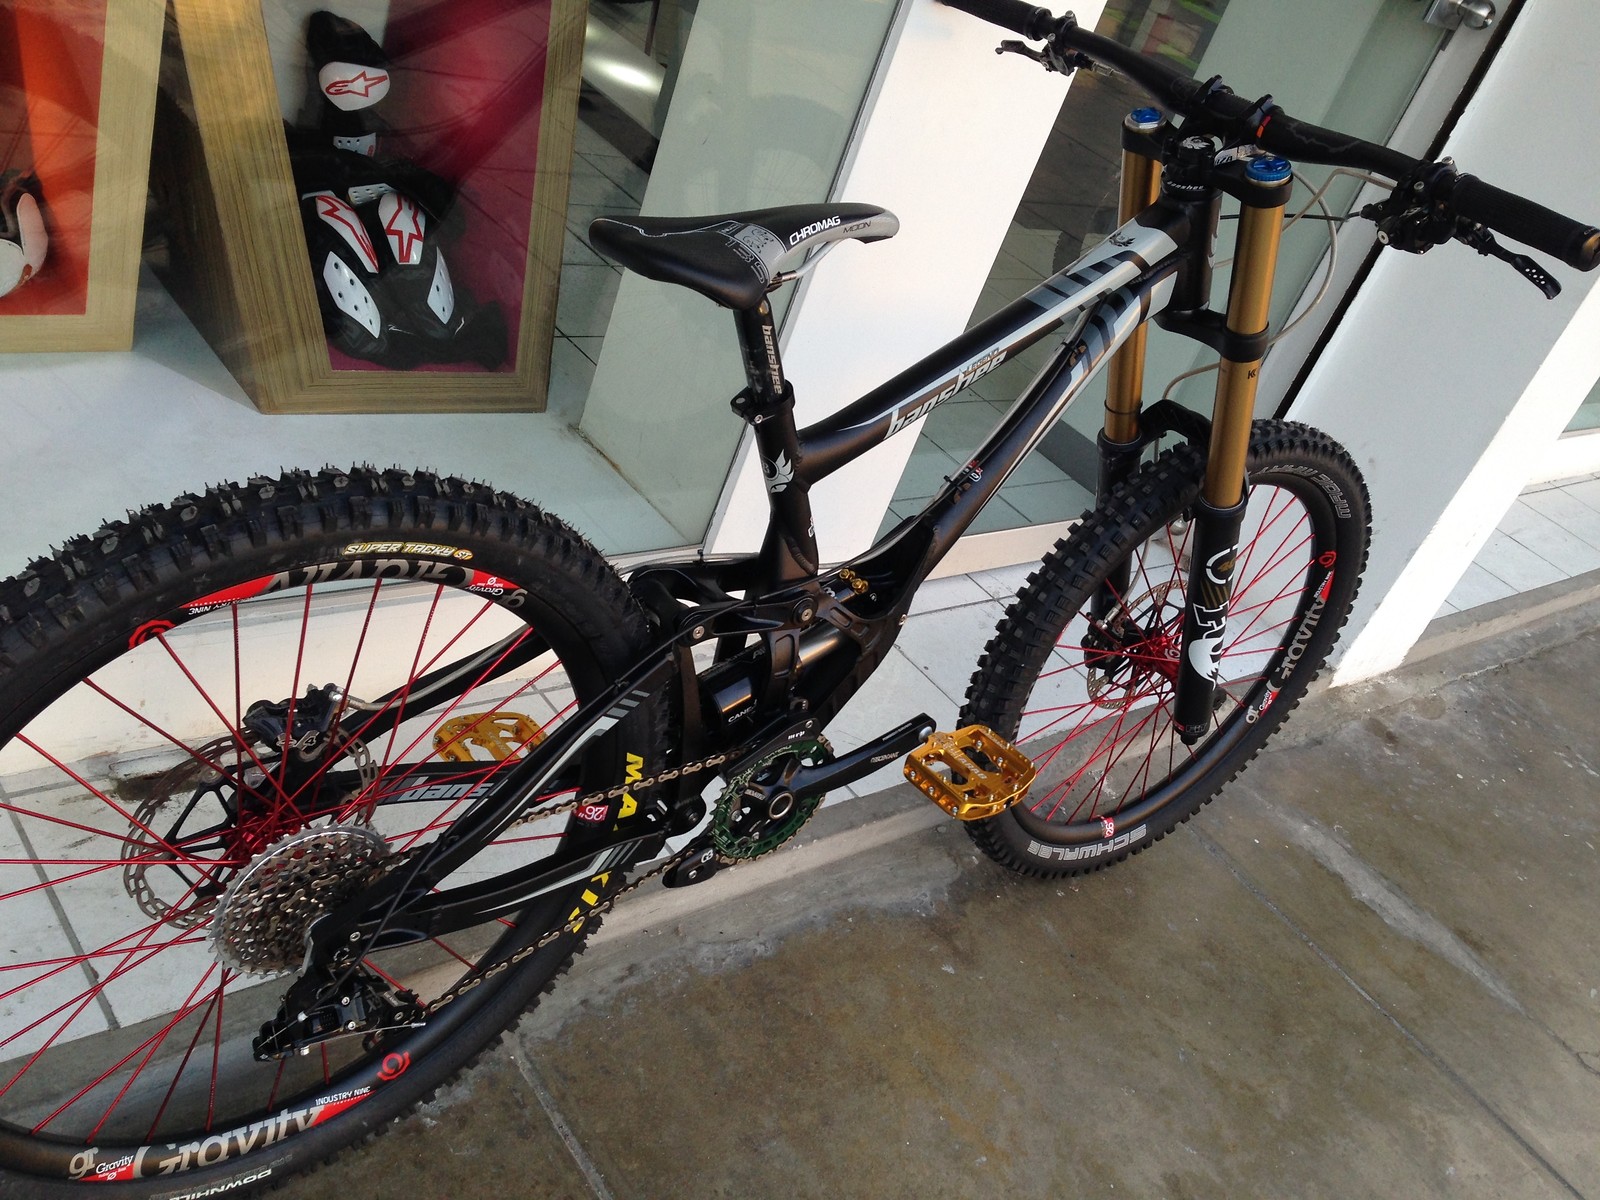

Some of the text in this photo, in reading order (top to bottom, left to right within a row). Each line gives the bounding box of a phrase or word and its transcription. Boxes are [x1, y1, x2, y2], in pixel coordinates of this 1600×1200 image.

[789, 215, 841, 246] CHROMAG
[843, 220, 872, 234] MOON
[762, 324, 783, 394] banshee
[883, 351, 1008, 440] banshee
[343, 542, 401, 556] SUPER
[402, 543, 458, 556] TACKY
[1266, 594, 1327, 693] Gravity
[1027, 823, 1148, 860] SCHWALBE
[315, 1086, 371, 1106] INDUSTRY NINE
[132, 1106, 324, 1179] Gravity
[96, 1154, 134, 1174] Gravity
